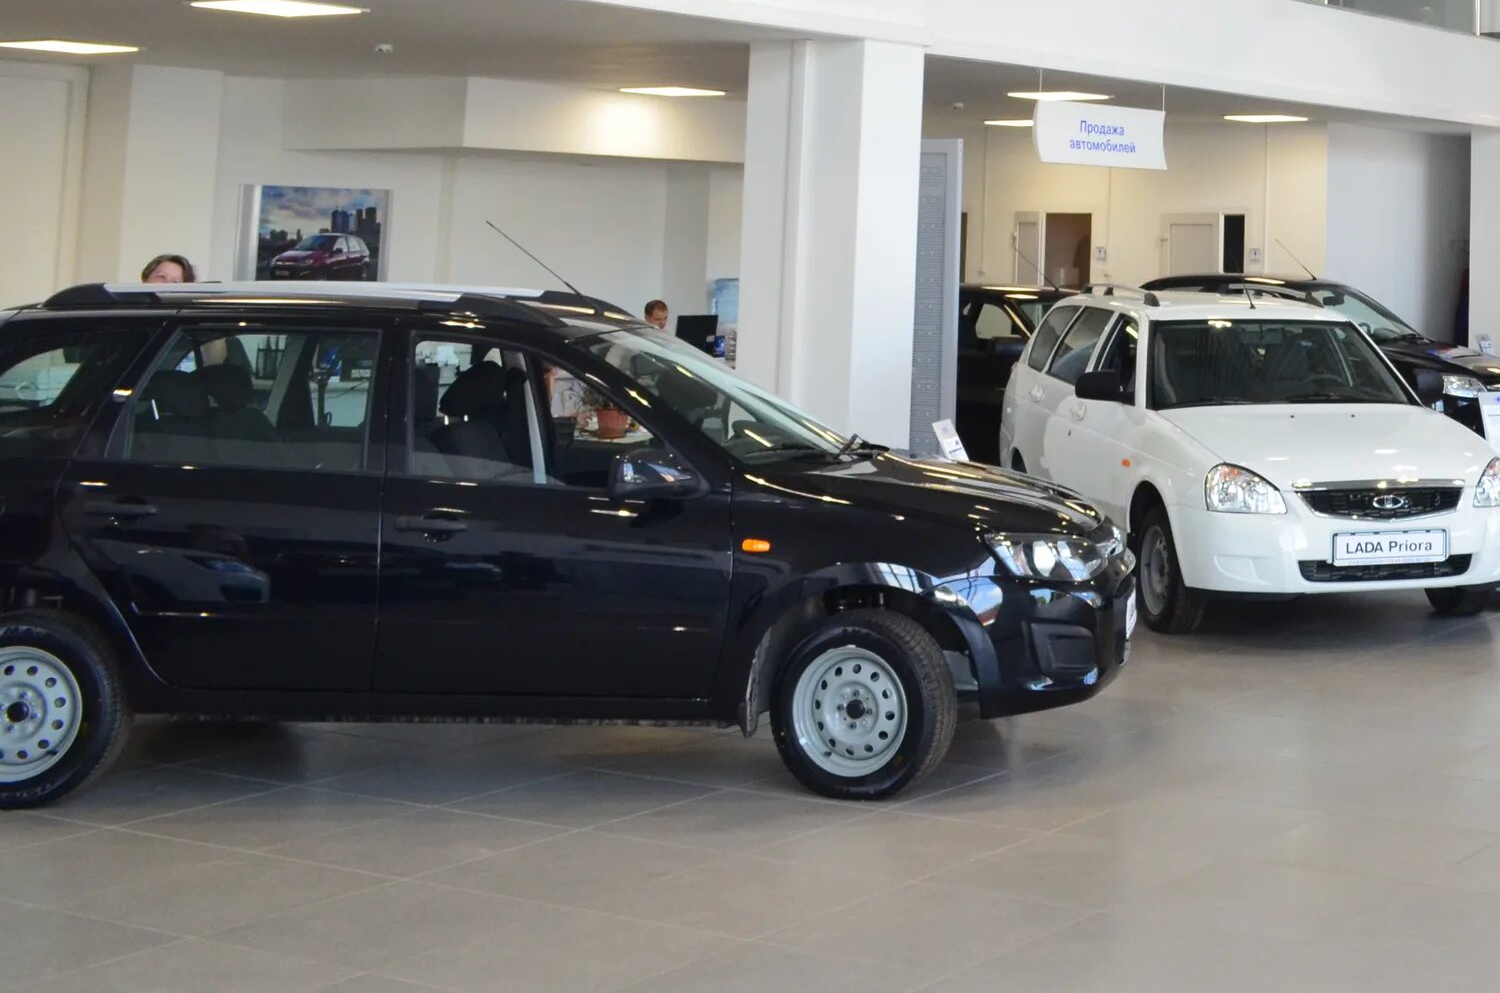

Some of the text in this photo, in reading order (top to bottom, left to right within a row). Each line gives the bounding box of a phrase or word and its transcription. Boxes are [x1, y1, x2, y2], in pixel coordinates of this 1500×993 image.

[1080, 120, 1125, 136] Продажа
[1069, 138, 1136, 153] автомобилей
[1346, 539, 1433, 554] LADA Priora
